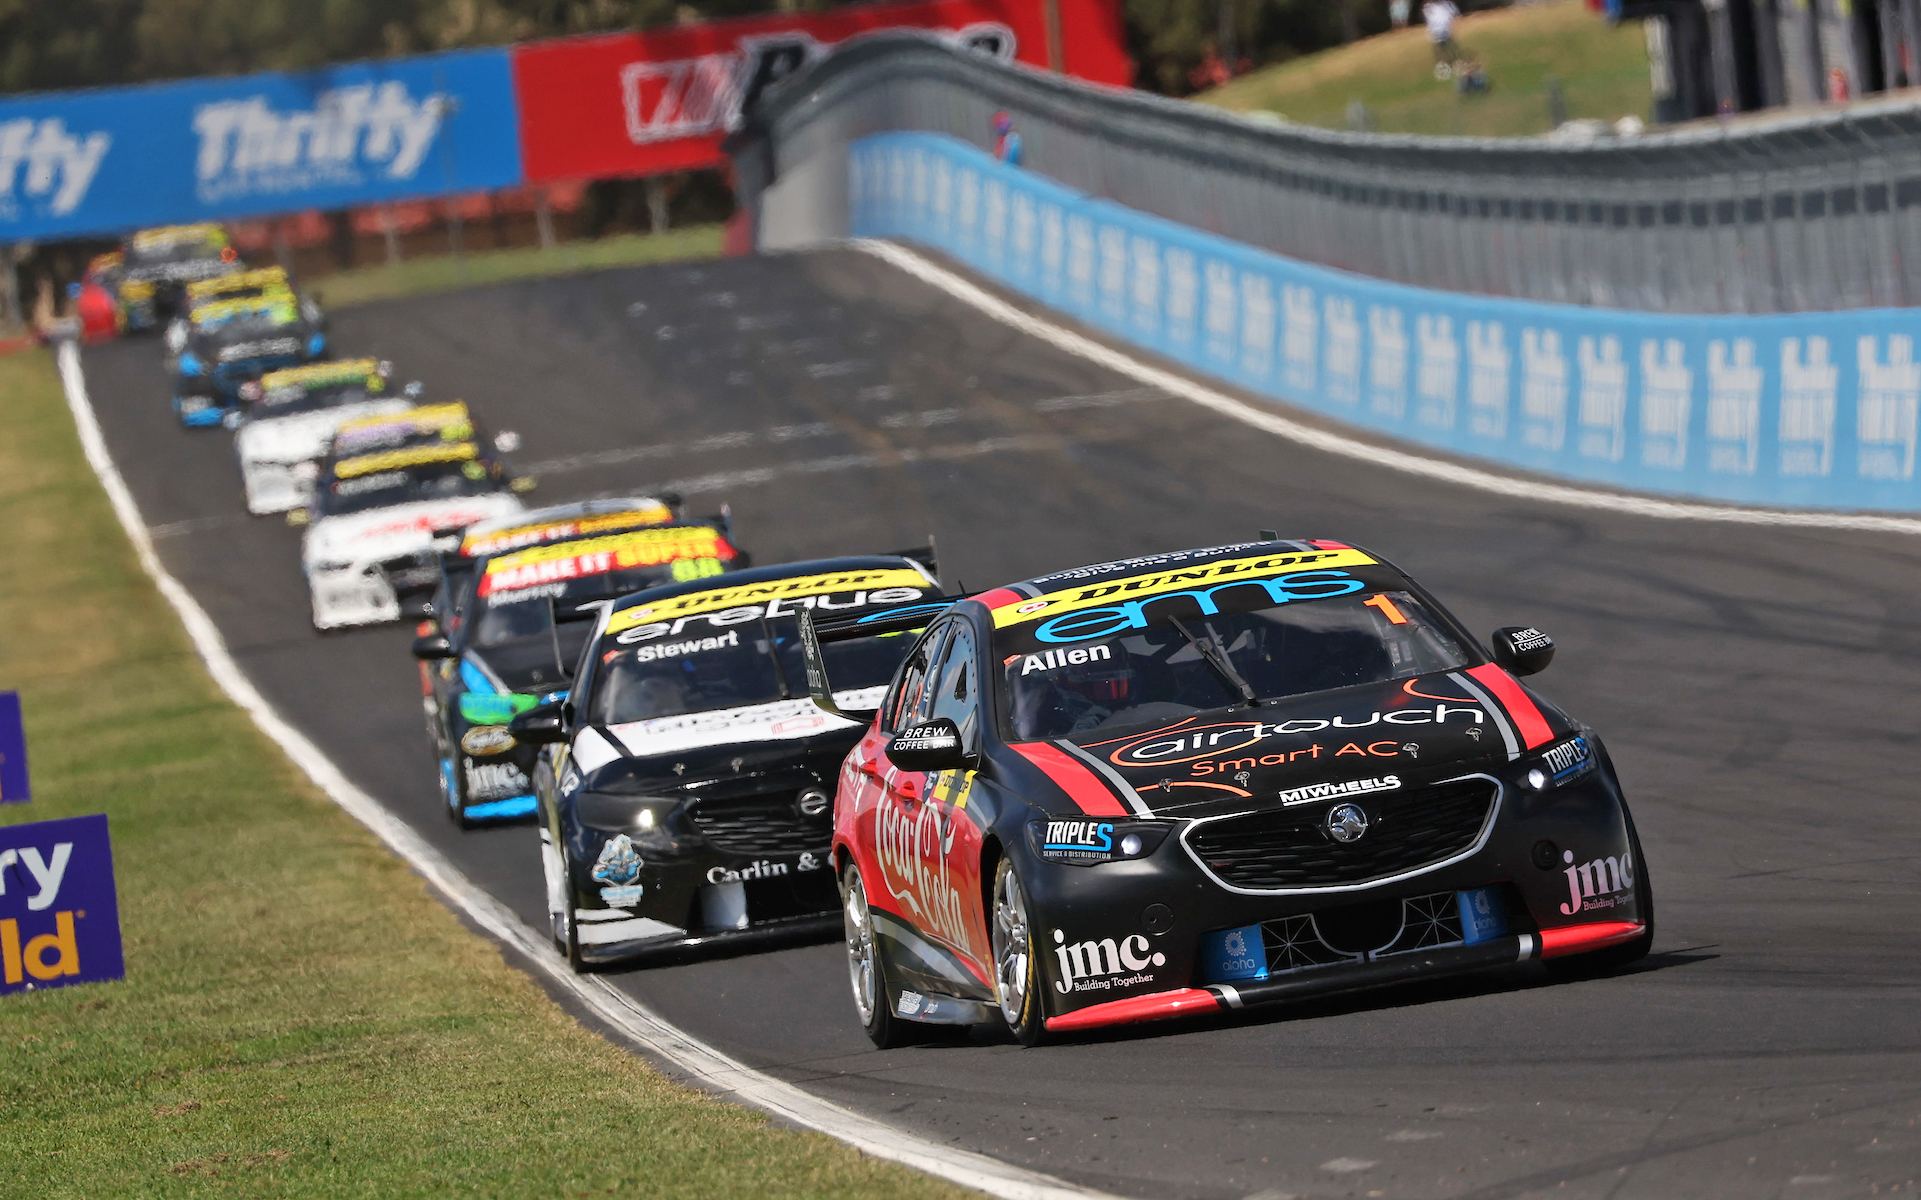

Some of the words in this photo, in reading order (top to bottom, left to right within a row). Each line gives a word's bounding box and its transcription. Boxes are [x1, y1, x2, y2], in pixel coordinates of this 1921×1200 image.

[193, 80, 446, 180] Thrifty
[676, 574, 884, 609] DUNLOP
[1072, 552, 1339, 602] DUNLOP
[1034, 570, 1365, 643] ems
[1363, 594, 1408, 626] 1
[637, 630, 739, 662] Stewart
[1021, 644, 1111, 676] Allen
[893, 740, 929, 751] COFFEE
[932, 739, 954, 749] BAR
[904, 726, 949, 739] BREW
[1131, 704, 1484, 759] airtouch
[1190, 743, 1323, 777] Smart
[1334, 740, 1399, 758] AC
[706, 860, 788, 885] Carlin
[797, 852, 820, 871] &
[1068, 851, 1112, 860] DISTRIBUTION
[1583, 897, 1615, 911] Building
[1054, 929, 1166, 994] jmc.
[1222, 957, 1255, 971] aloha
[1074, 979, 1111, 992] Building
[1111, 973, 1153, 987] Together
